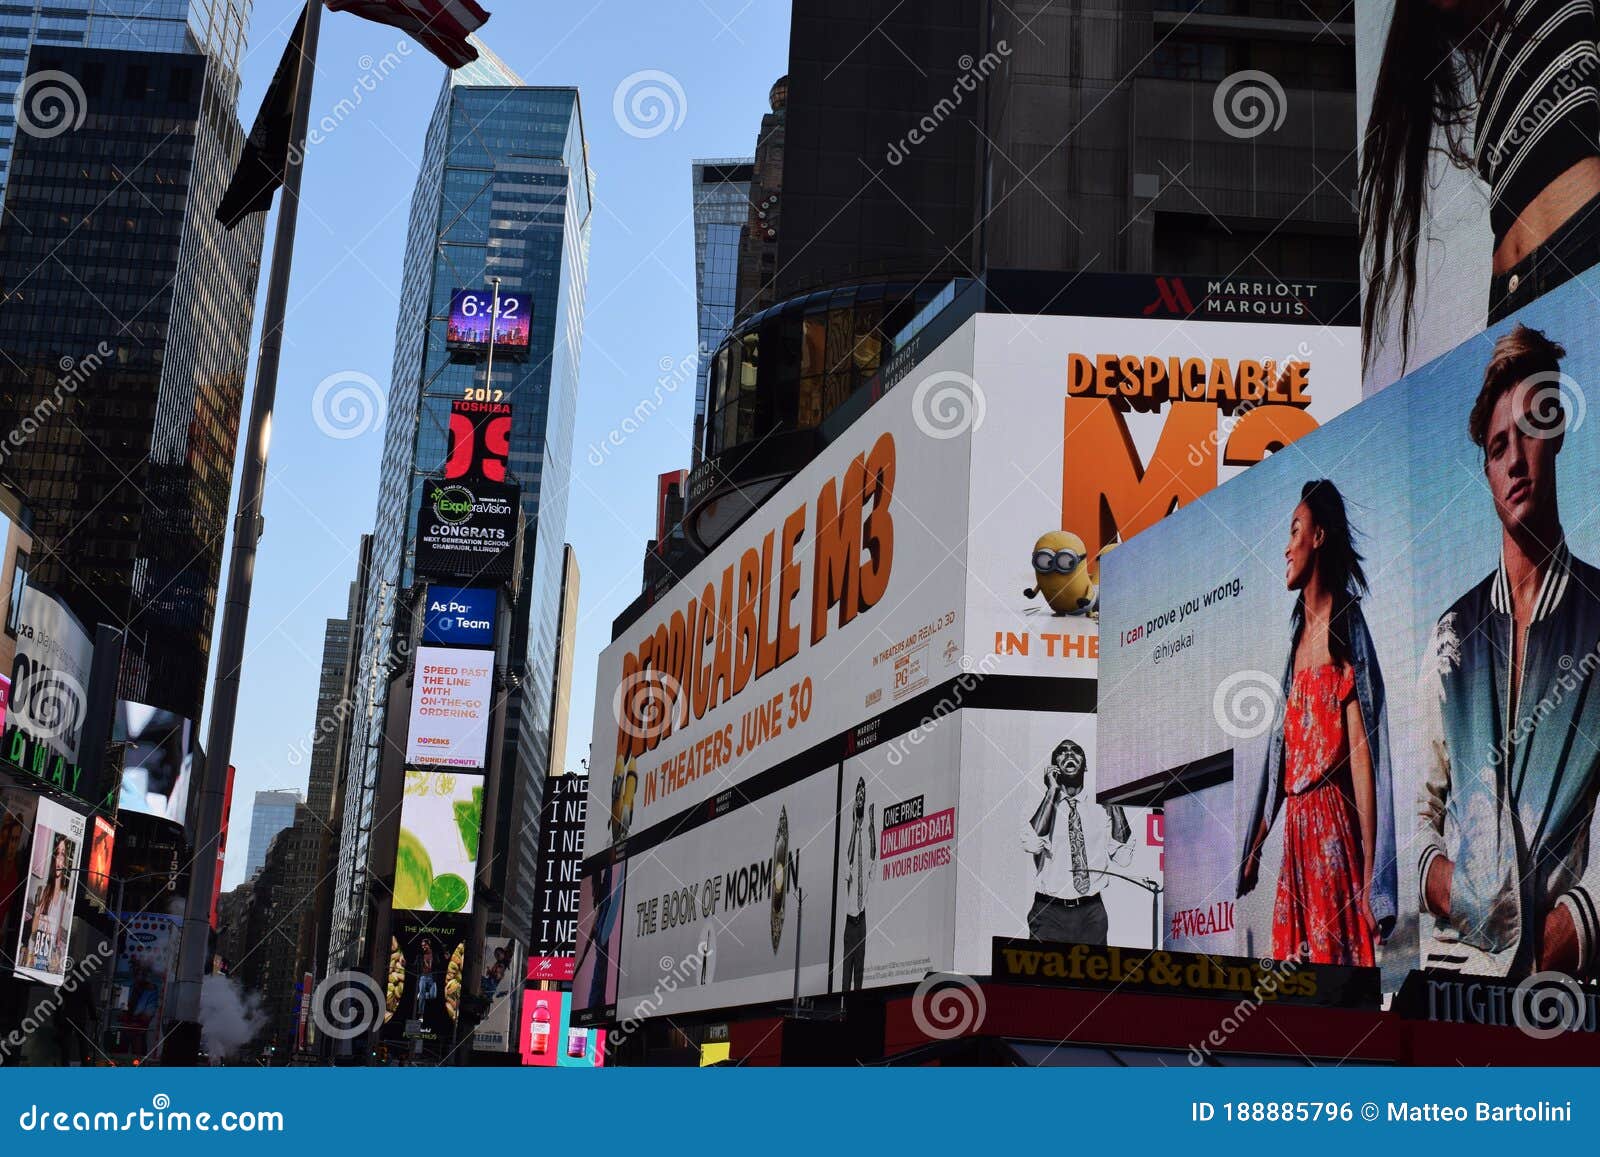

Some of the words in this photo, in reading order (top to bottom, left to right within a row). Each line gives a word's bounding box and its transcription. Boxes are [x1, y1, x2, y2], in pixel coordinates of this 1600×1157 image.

[1207, 281, 1318, 297] MARRIOTT
[462, 295, 519, 319] 6:42
[1207, 300, 1305, 315] MARQUIS
[1067, 353, 1312, 403] DESPICABLE
[453, 401, 510, 413] TOSHIBA
[440, 500, 511, 515] ExploraVision
[430, 525, 505, 539] CONGRATS
[442, 538, 482, 546] GENERATION
[616, 503, 806, 765] DESPICABLE
[810, 431, 896, 648] M3
[431, 602, 447, 612] As
[1126, 625, 1144, 645] can
[1146, 612, 1176, 640] prove
[1178, 597, 1200, 622] you
[1202, 577, 1245, 608] wrong.
[456, 617, 490, 630] Team
[995, 631, 1029, 657] IN
[1153, 629, 1195, 665] @hiyakai
[423, 665, 458, 675] SPEED
[461, 668, 489, 677] PAST
[895, 668, 909, 689] PG
[423, 676, 444, 685] THE
[446, 677, 472, 687] LINE
[422, 686, 451, 695] WITH
[421, 696, 482, 708] ON-THE-GO
[420, 707, 479, 719] ORDERING.
[857, 719, 881, 737] MARRIOTT
[643, 769, 657, 807] IN
[661, 723, 733, 798] THEATERS
[736, 692, 783, 757] JUNE
[787, 676, 813, 730] 30
[857, 731, 877, 747] MARQUIS
[885, 805, 899, 827] ONE
[900, 798, 922, 820] PRICE
[882, 824, 927, 855] UNLIMITED
[928, 815, 952, 843] DATA
[882, 864, 891, 881] IN
[892, 856, 912, 877] YOUR
[913, 845, 951, 873] BUSINESS
[636, 898, 658, 938] THE
[661, 883, 698, 931] BOOK
[702, 875, 722, 918] OF
